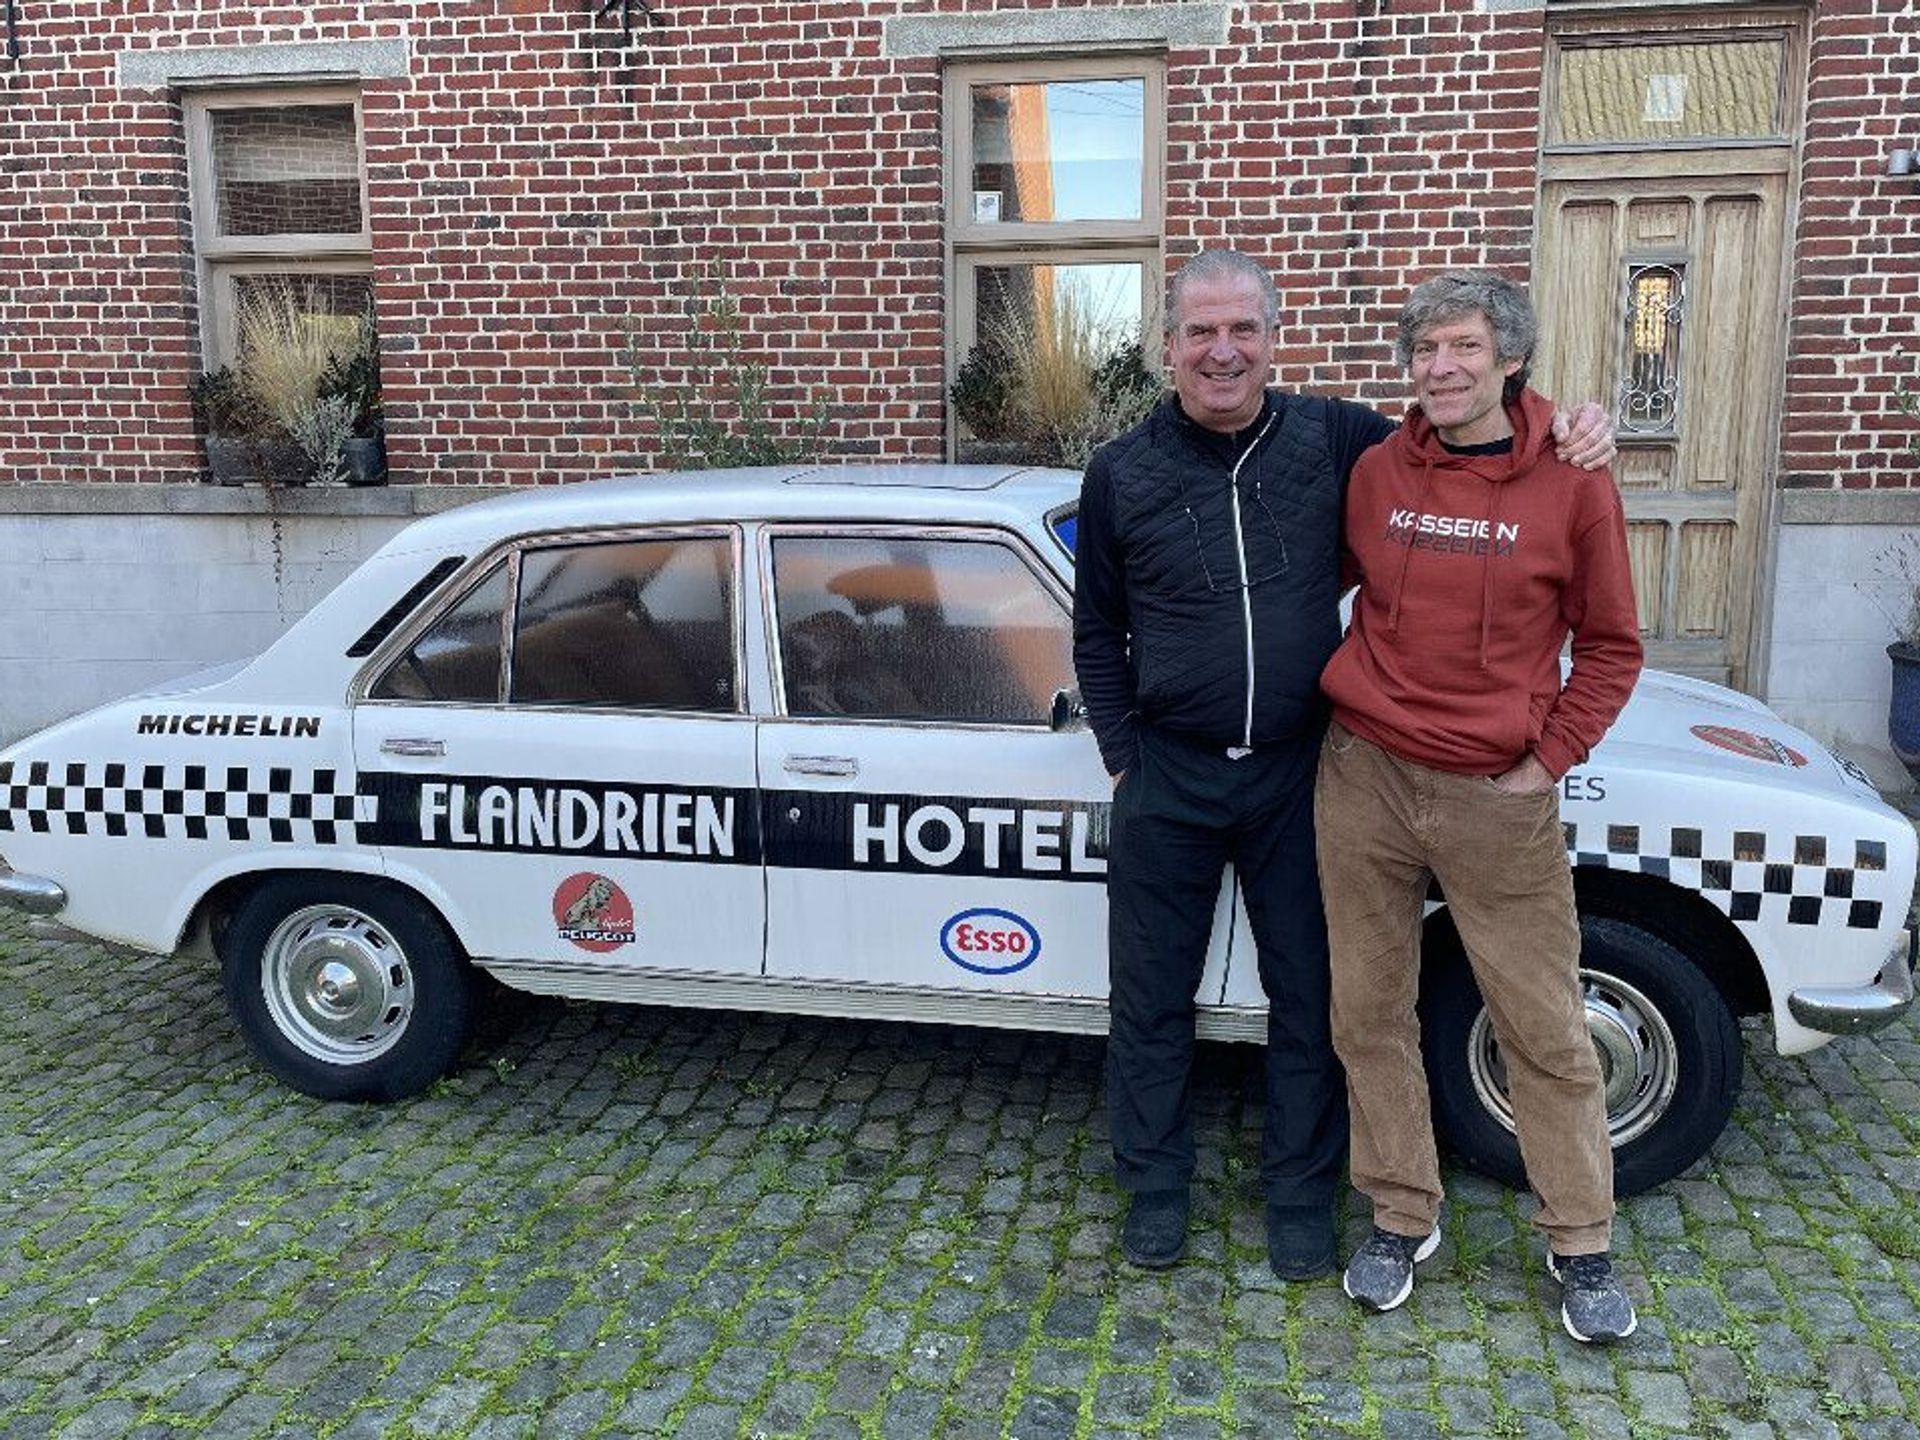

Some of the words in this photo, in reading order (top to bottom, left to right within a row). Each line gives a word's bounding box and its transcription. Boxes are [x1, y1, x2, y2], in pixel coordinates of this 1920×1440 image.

[137, 714, 321, 738] MICHELIN
[419, 783, 736, 858] FLANDRIEN
[852, 802, 1109, 874] HOTEL
